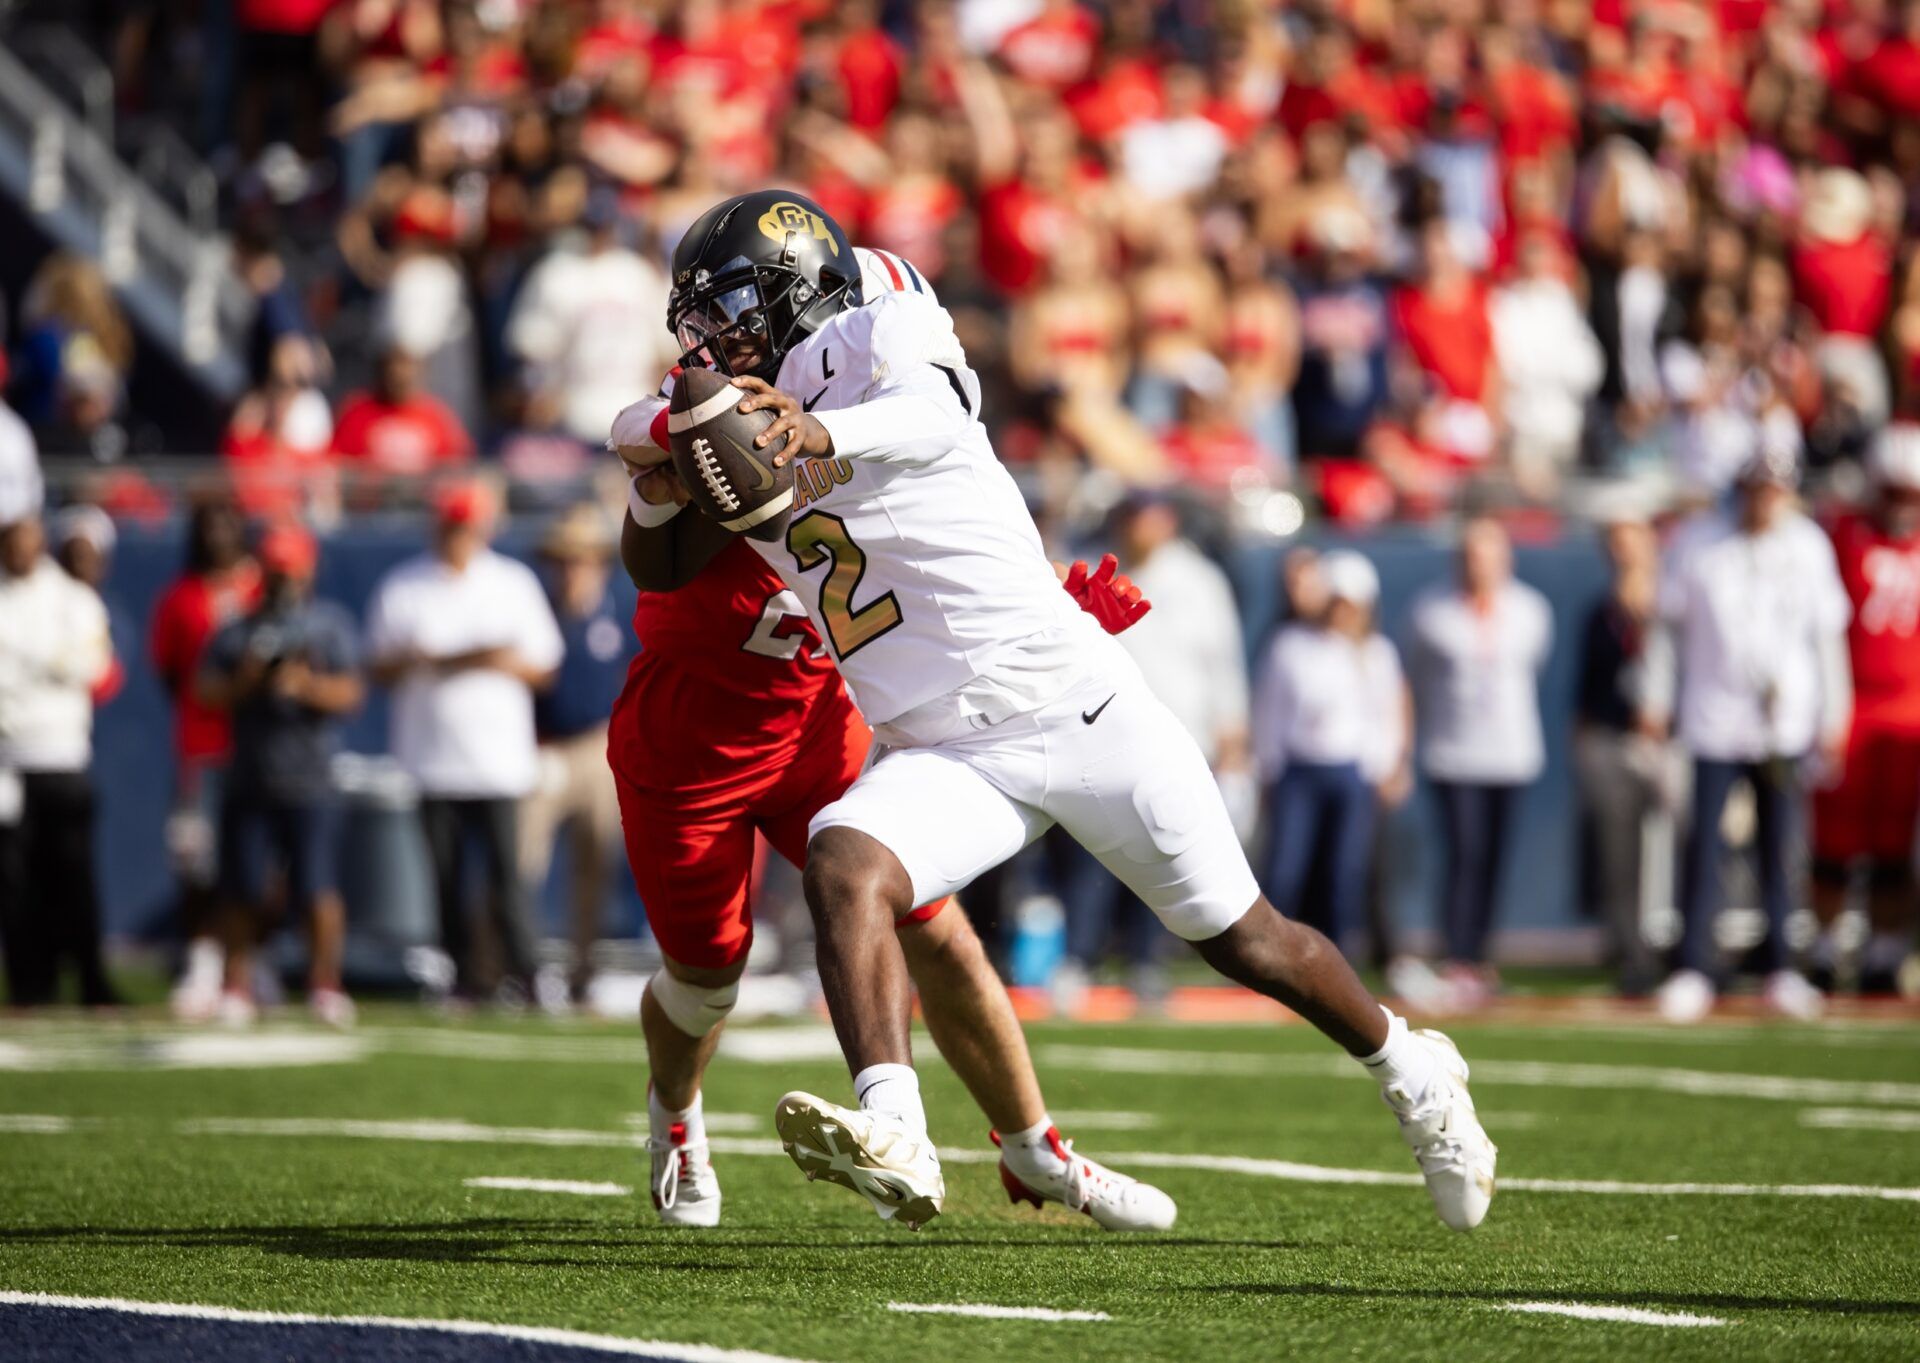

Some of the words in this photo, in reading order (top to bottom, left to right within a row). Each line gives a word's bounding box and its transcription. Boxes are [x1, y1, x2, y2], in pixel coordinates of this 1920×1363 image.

[822, 347, 835, 381] L
[793, 457, 854, 512] ADO
[786, 508, 904, 663] 2
[741, 588, 828, 660] 2
